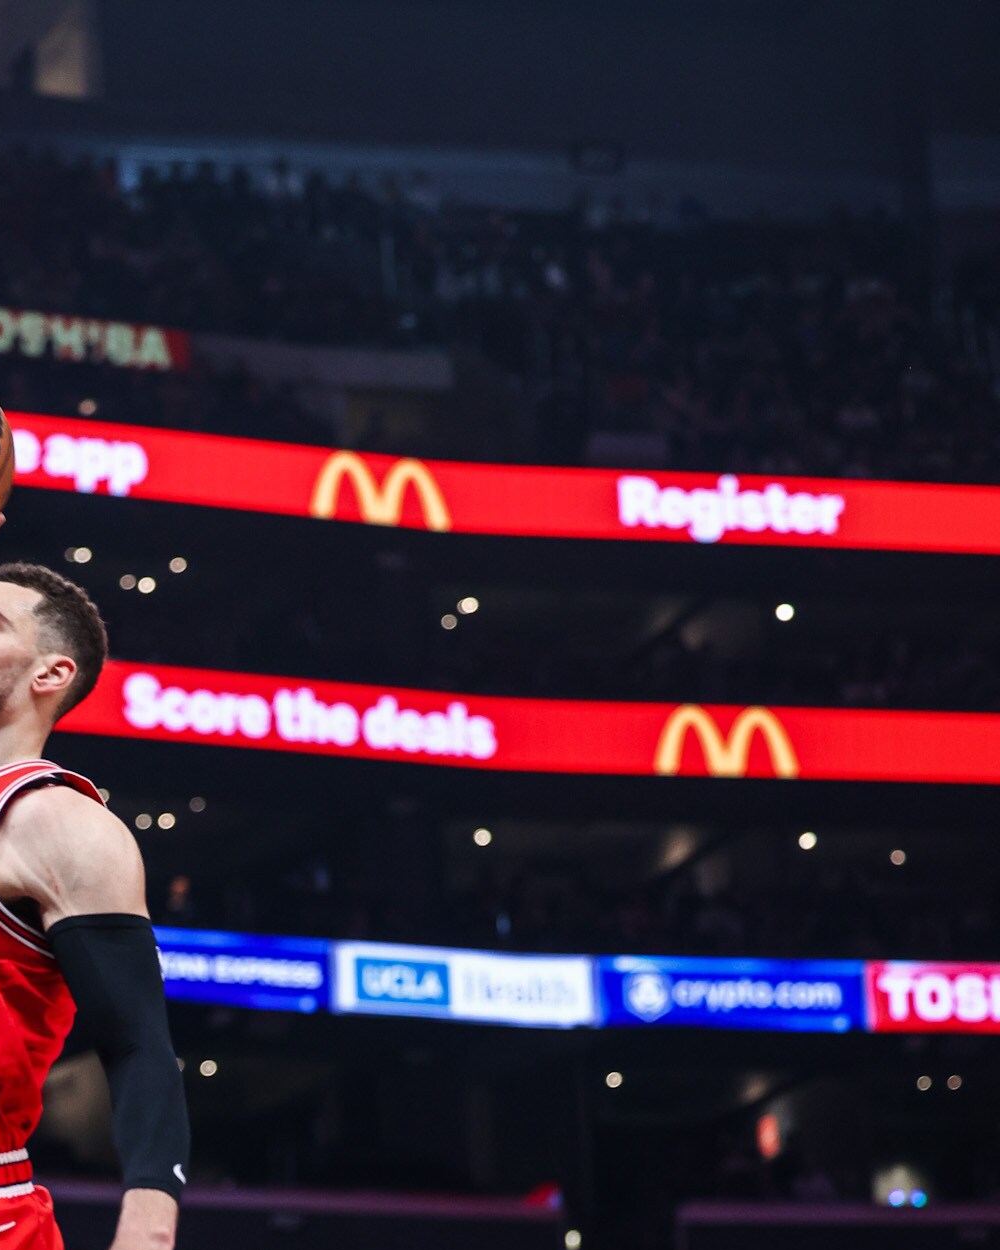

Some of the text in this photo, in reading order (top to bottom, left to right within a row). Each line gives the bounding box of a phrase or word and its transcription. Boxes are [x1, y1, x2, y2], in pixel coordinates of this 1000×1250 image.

[43, 432, 148, 497] app
[617, 473, 845, 544] Register
[123, 672, 498, 760] Score the deals
[361, 963, 444, 1001] UCLA
[672, 977, 843, 1014] crypto.com
[877, 971, 1000, 1023] TOS
